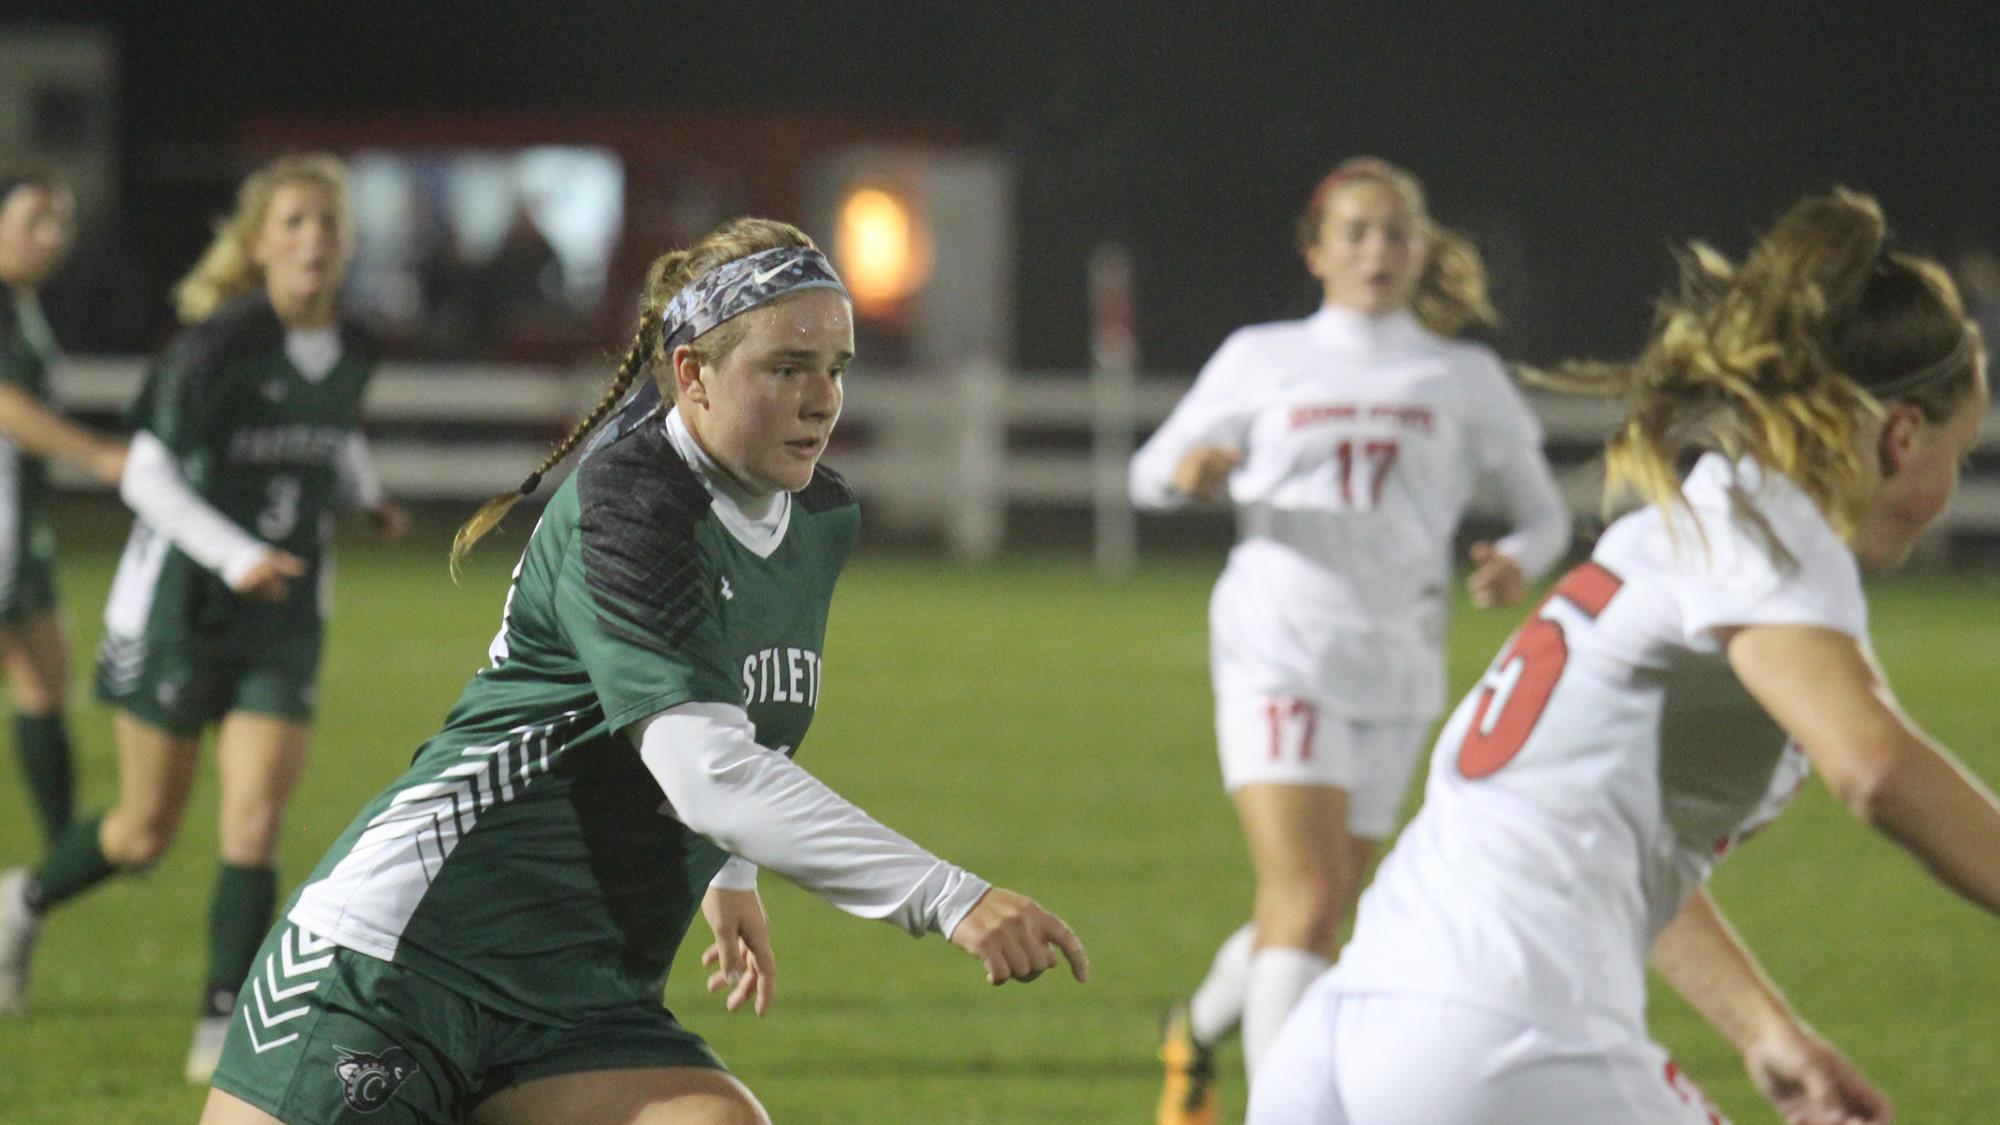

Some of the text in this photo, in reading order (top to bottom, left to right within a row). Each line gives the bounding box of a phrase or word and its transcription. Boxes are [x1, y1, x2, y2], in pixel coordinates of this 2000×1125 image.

[1336, 440, 1400, 506] 17
[257, 474, 300, 540] 3
[743, 647, 821, 710] STLET
[1457, 561, 1624, 780] 5
[1263, 697, 1319, 762] 17
